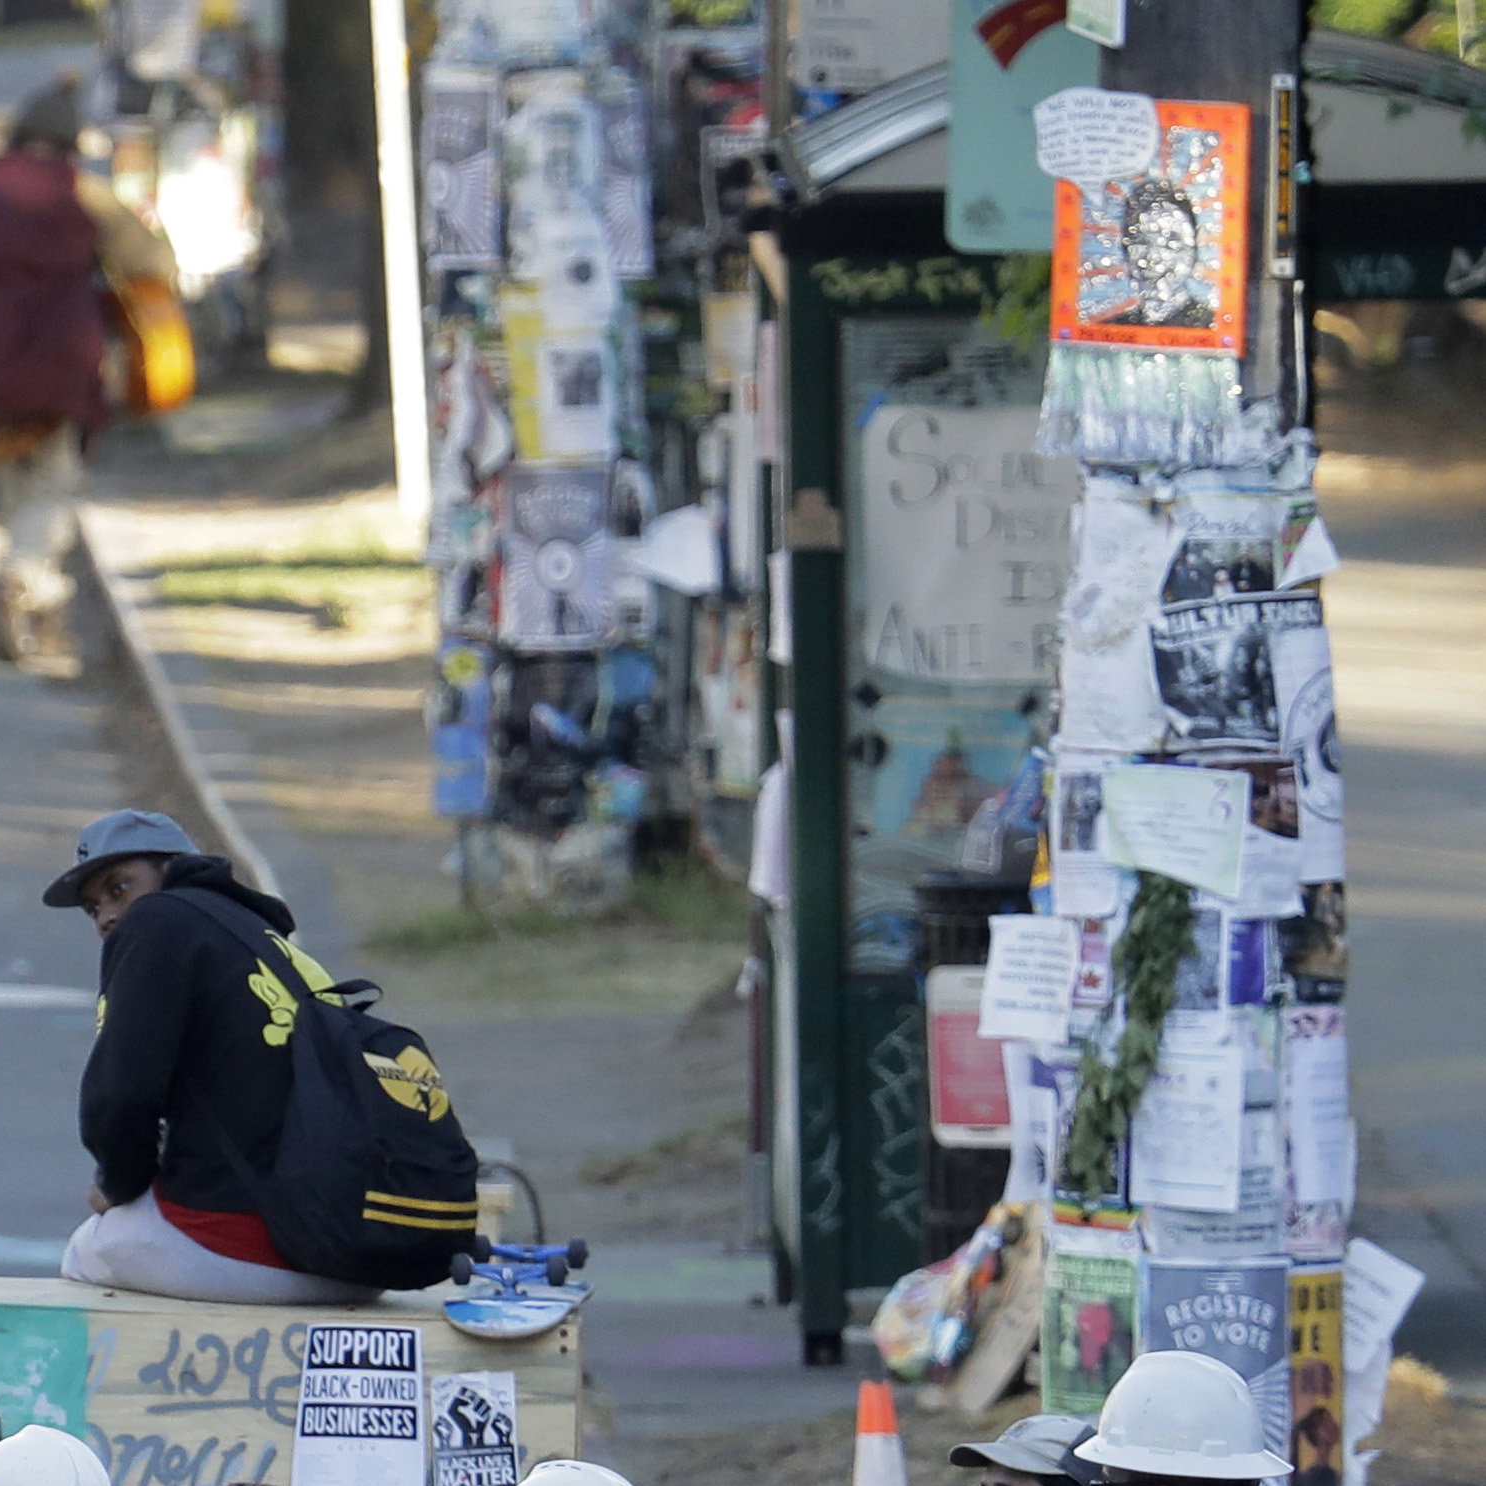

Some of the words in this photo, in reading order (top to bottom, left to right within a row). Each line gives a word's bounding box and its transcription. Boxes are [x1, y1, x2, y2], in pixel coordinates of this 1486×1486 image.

[1165, 1295, 1276, 1330] REGISTER
[311, 1329, 413, 1368] SUPPORT
[1173, 1325, 1206, 1349] TO
[1211, 1320, 1272, 1354] VOTE
[304, 1374, 417, 1400] BLACK-OWNED
[303, 1405, 415, 1437] BUSINESSES
[478, 1455, 511, 1467] LIVES
